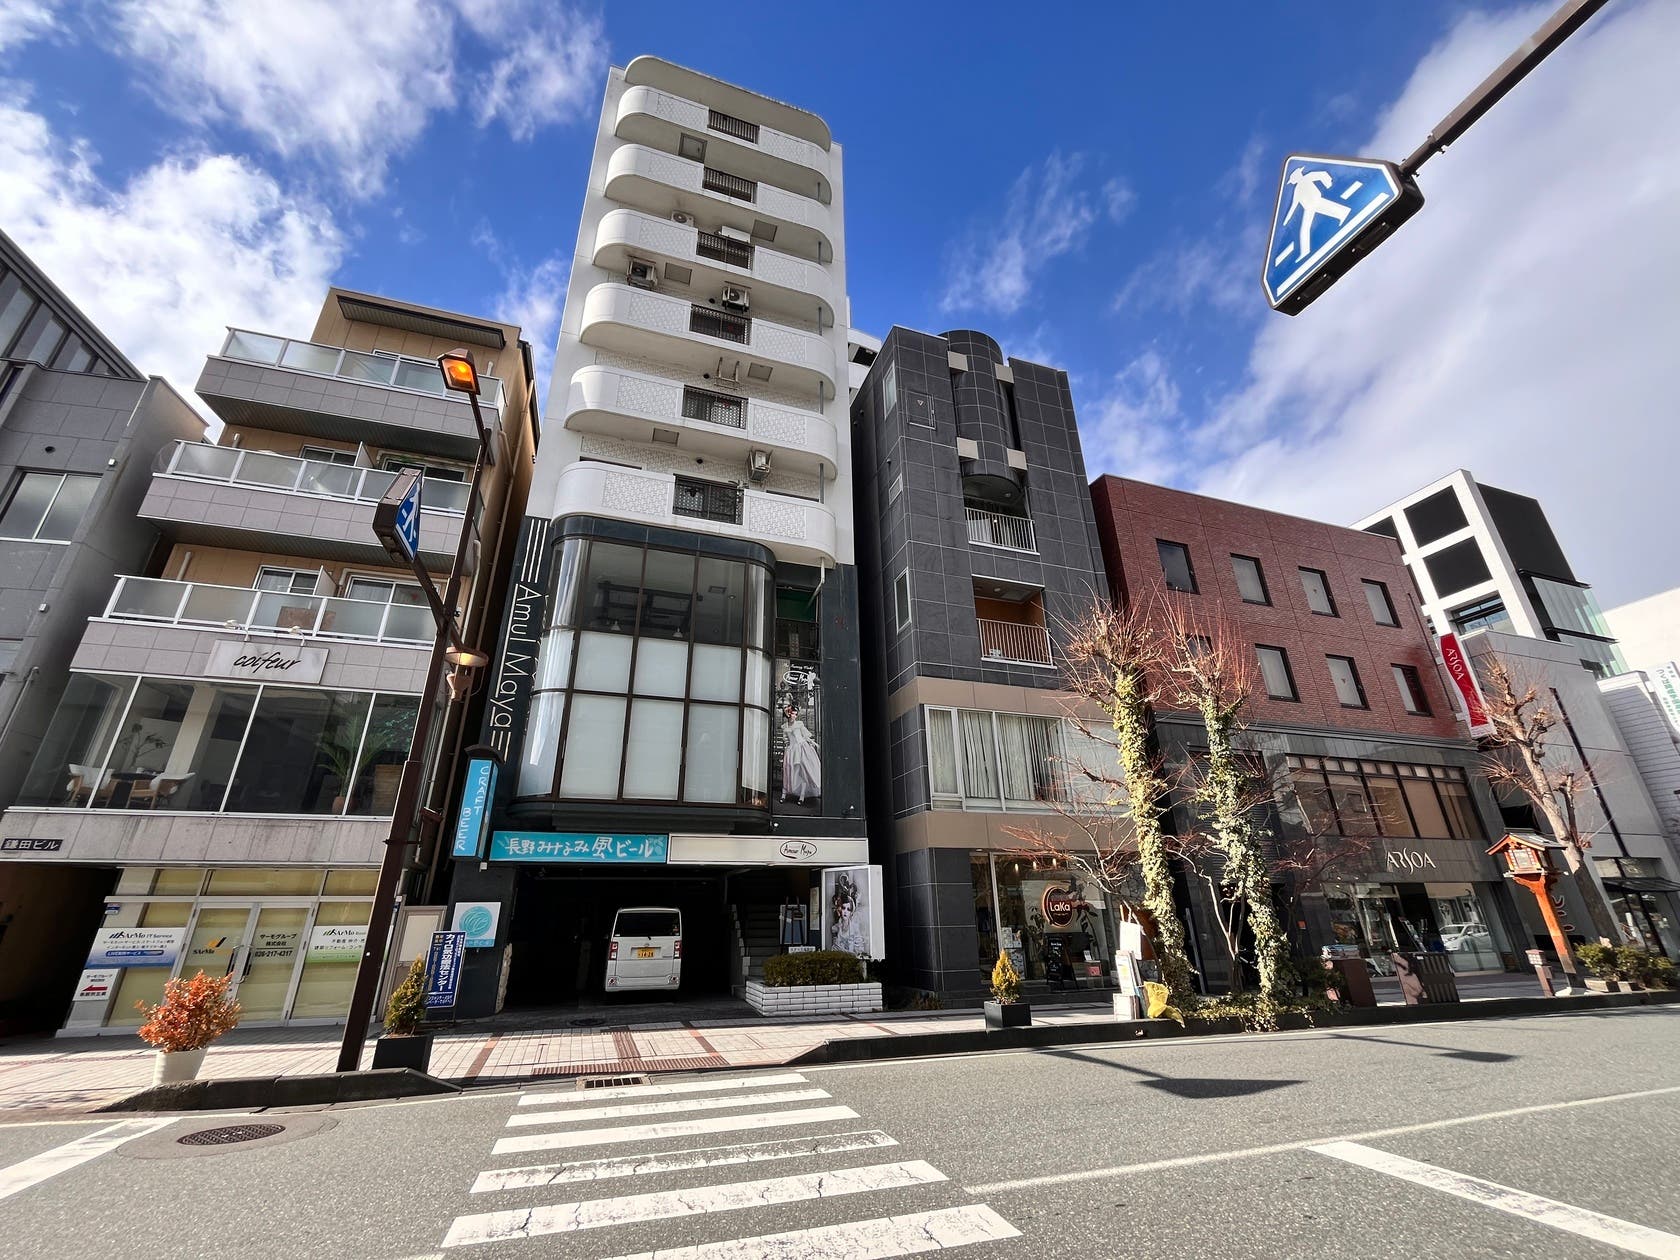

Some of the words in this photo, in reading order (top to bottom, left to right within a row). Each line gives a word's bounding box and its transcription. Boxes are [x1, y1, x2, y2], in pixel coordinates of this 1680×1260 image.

[509, 584, 542, 642] Amul
[490, 652, 531, 728] Maya
[474, 765, 489, 815] CRAFT
[455, 808, 471, 850] BEER
[1386, 847, 1436, 875] ARSOA
[1049, 901, 1071, 912] LaKa
